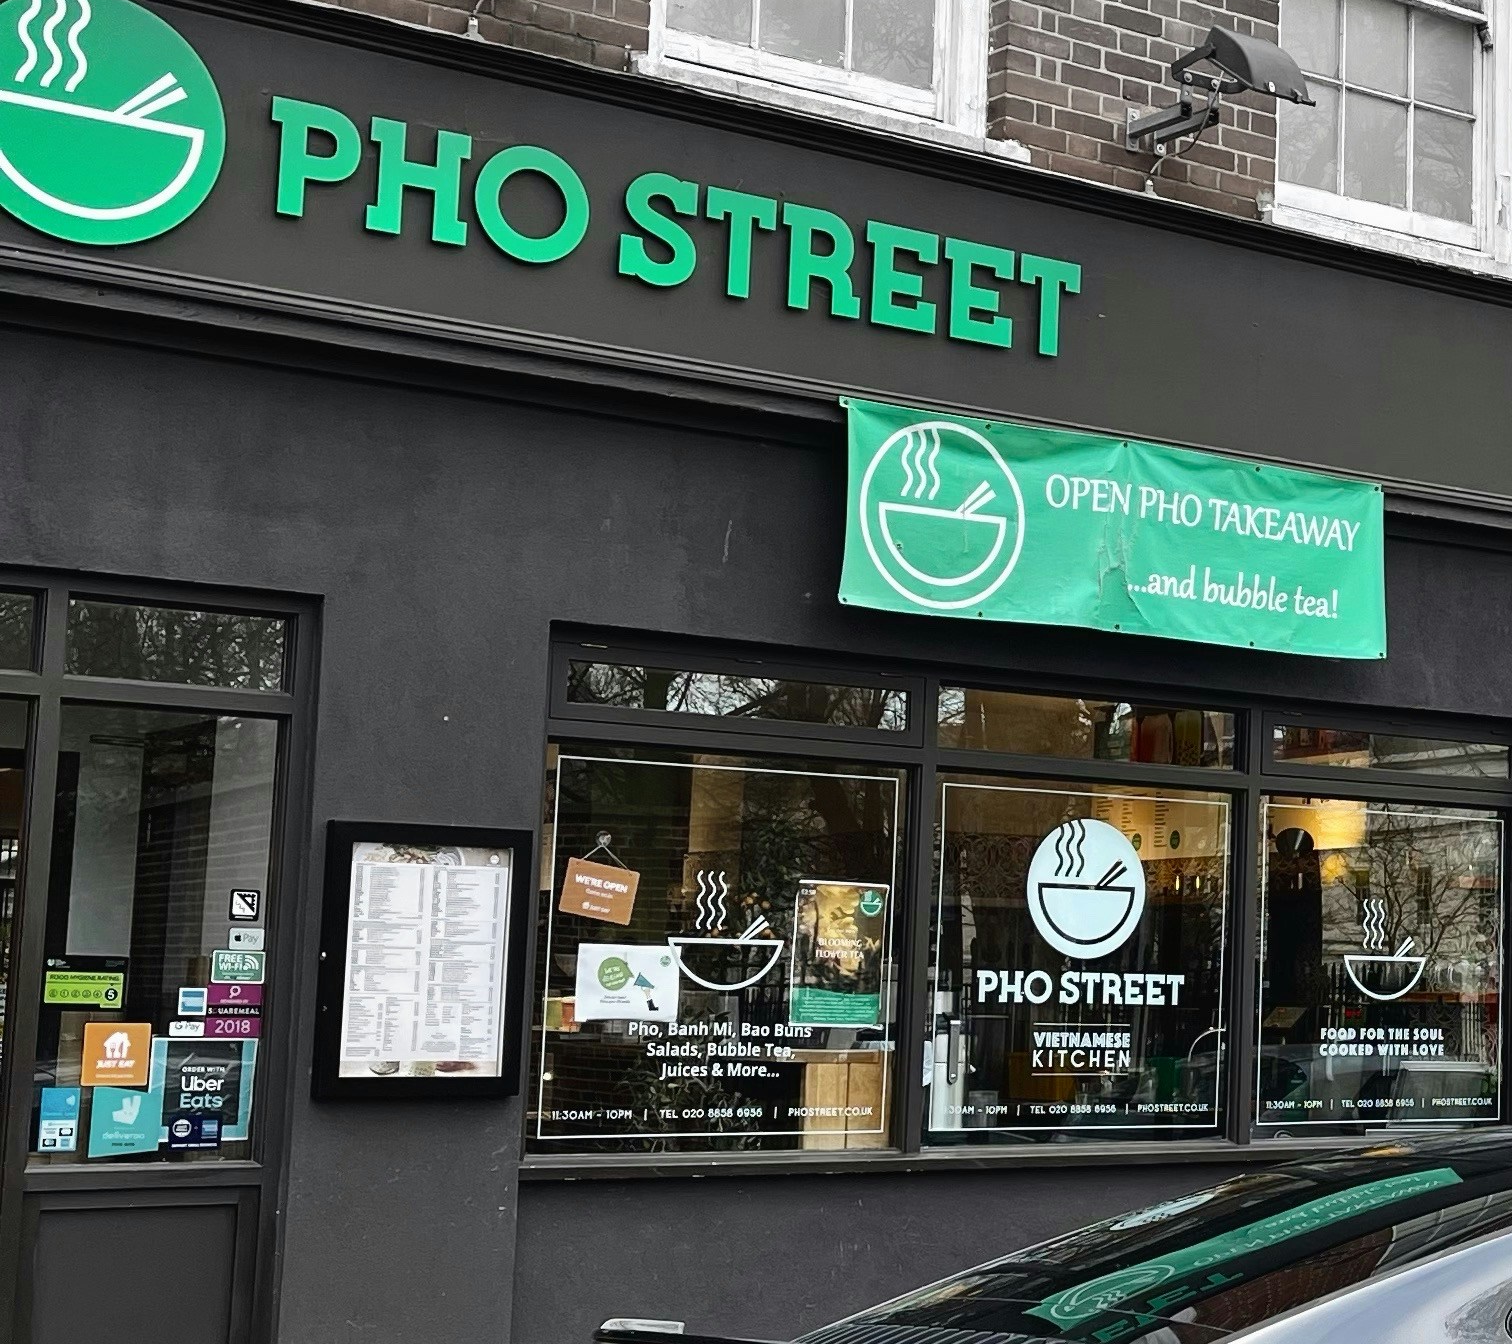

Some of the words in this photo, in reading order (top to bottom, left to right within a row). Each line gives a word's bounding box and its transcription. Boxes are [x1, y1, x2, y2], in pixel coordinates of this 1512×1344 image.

[271, 95, 590, 264] PHO
[618, 172, 1082, 356] STREET
[1045, 474, 1132, 515] OPEN
[1139, 486, 1202, 527] PHO
[1208, 498, 1360, 551] TAKEAWAY
[1203, 566, 1289, 612] bubble
[1293, 585, 1339, 619] tea!
[243, 933, 259, 945] Pay
[218, 953, 243, 962] FREE
[976, 970, 1053, 1004] PHO
[1059, 970, 1185, 1006] STREET
[214, 1020, 251, 1034] 2018
[628, 1021, 663, 1038] Pho,
[667, 1022, 708, 1037] Banh
[713, 1022, 736, 1038] Mi,
[741, 1022, 770, 1037] Bao
[774, 1023, 813, 1038] Buns
[1320, 1027, 1356, 1041] FOOD
[1360, 1027, 1385, 1041] FOR
[1387, 1028, 1410, 1040] THE
[1413, 1028, 1444, 1041] SOUL
[1033, 1031, 1131, 1048] VIETNAMESE
[646, 1042, 702, 1058] Salads,
[707, 1042, 761, 1057] Bubble
[765, 1043, 796, 1059] Tea,
[1319, 1043, 1374, 1056] COOKED
[1377, 1043, 1409, 1056] WITH
[1412, 1043, 1445, 1056] LOVE
[1032, 1049, 1131, 1068] KITCHEN
[659, 1062, 708, 1080] Juices
[711, 1062, 724, 1077] &
[181, 1076, 225, 1092] Uber
[180, 1093, 223, 1109] Eats
[1341, 1099, 1355, 1108] TEL
[1357, 1099, 1373, 1107] 020
[606, 1109, 632, 1120] 10PM
[659, 1109, 678, 1119] TEL
[682, 1108, 705, 1119] 020
[985, 1105, 1008, 1115] 10PM
[1030, 1105, 1046, 1114] TEL
[1048, 1105, 1068, 1114] 020
